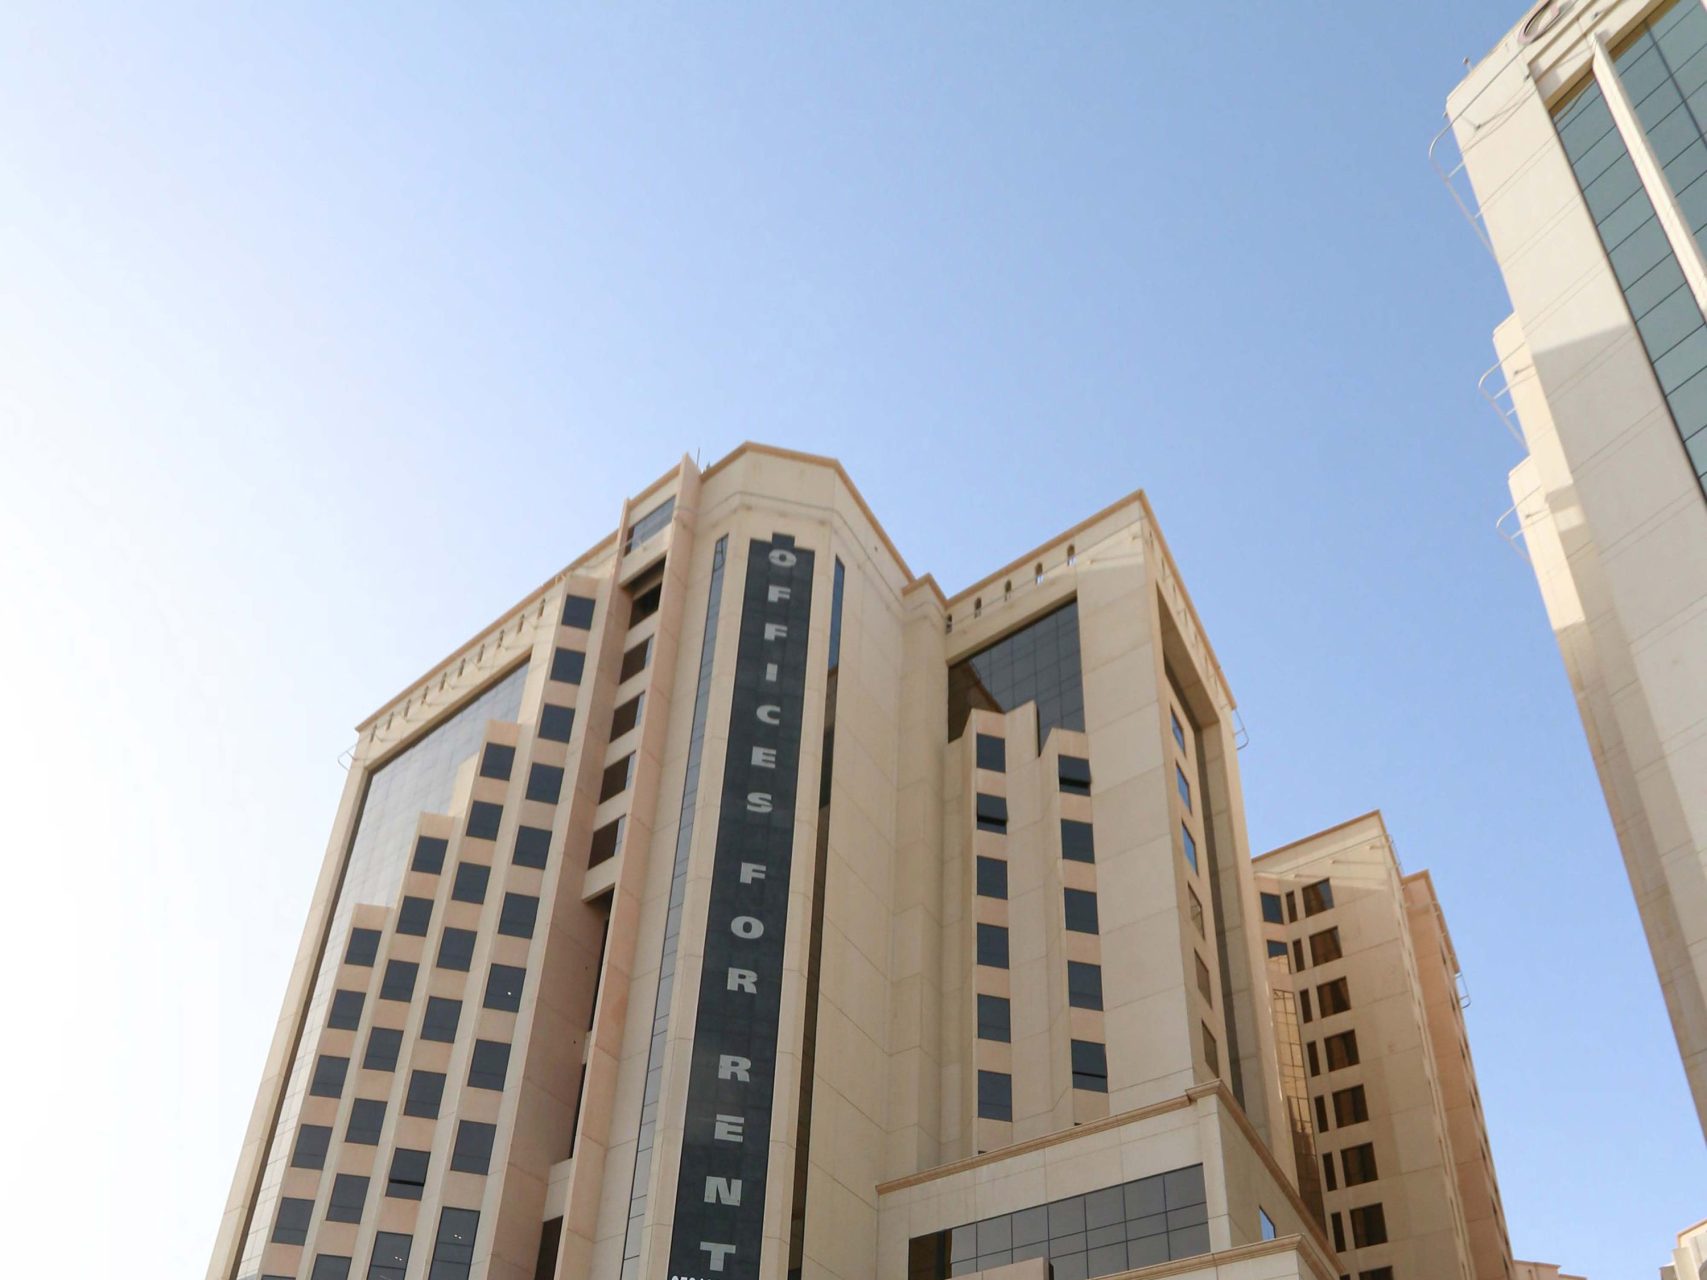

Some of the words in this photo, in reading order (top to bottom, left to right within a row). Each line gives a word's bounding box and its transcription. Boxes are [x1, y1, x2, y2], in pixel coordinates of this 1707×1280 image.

[744, 547, 797, 815] OFFICES
[726, 861, 767, 995] FOR
[699, 1053, 752, 1273] RENT
